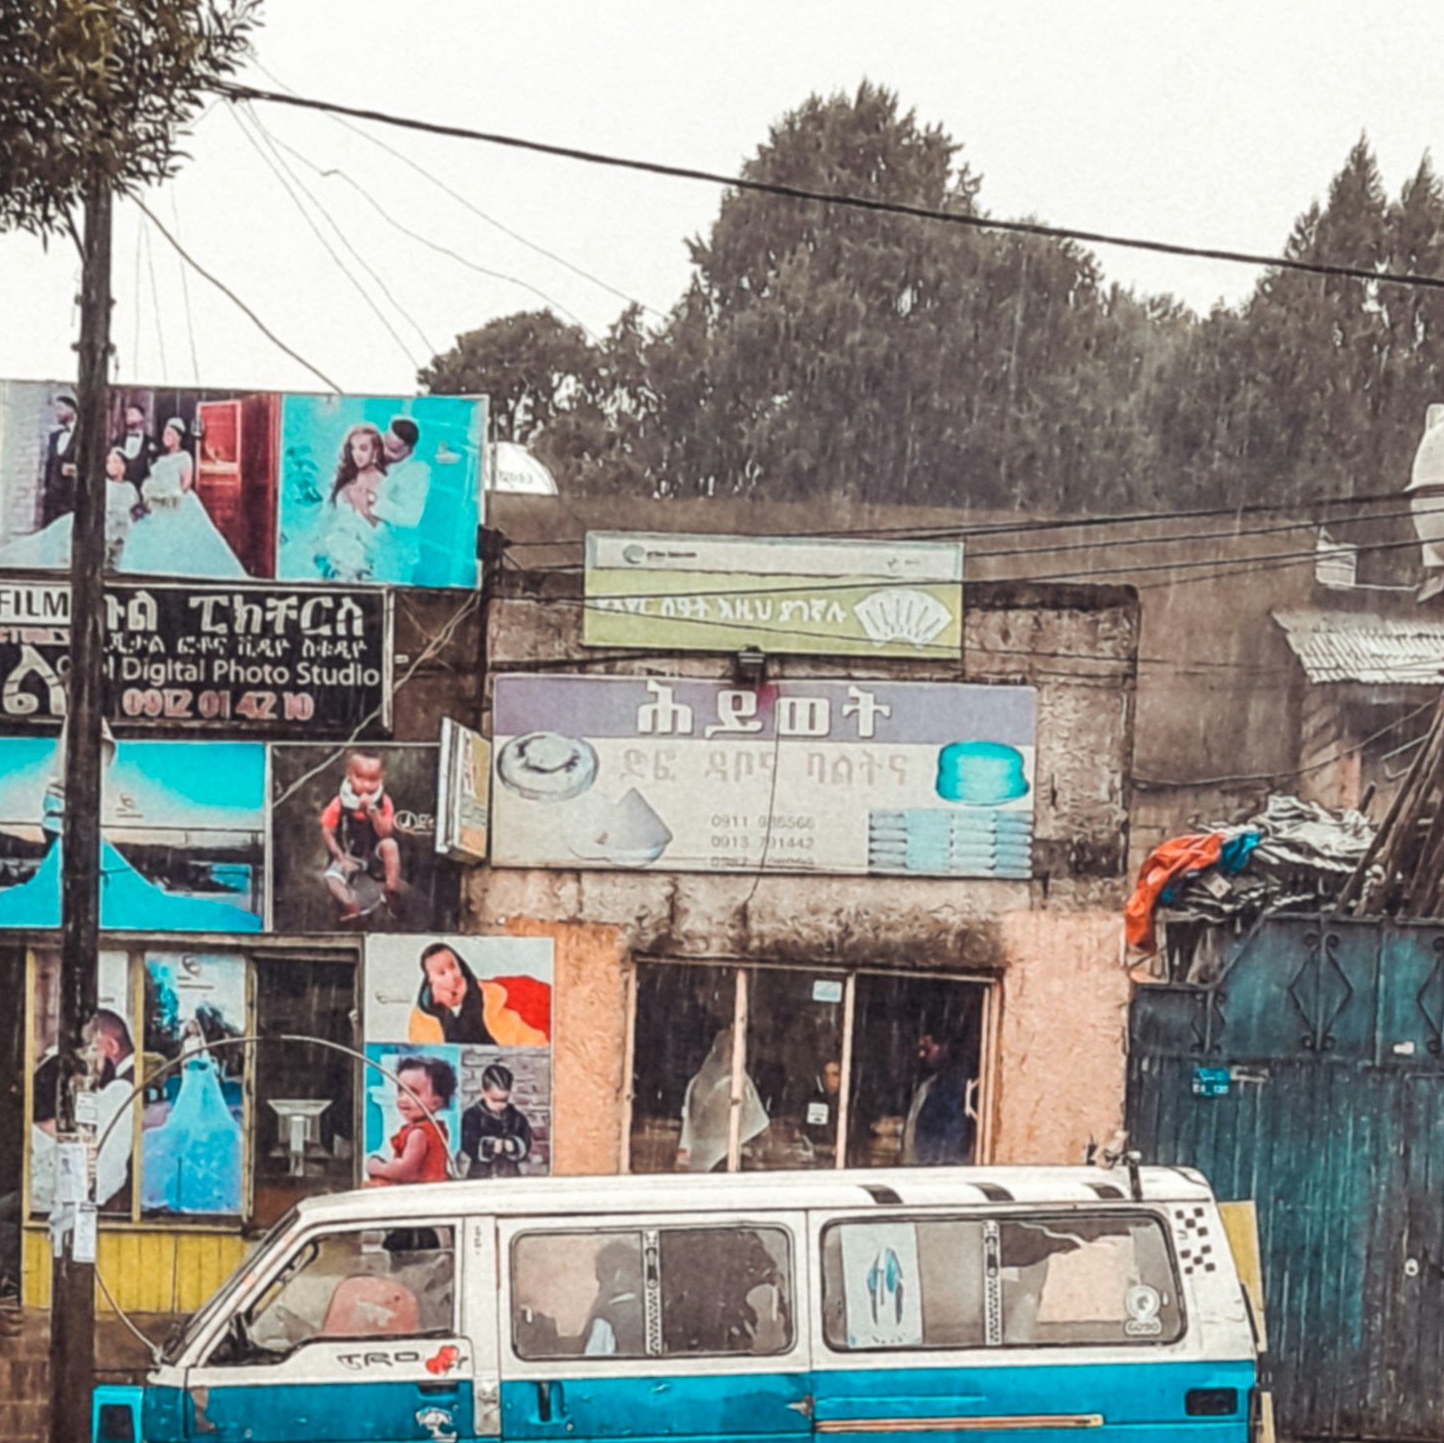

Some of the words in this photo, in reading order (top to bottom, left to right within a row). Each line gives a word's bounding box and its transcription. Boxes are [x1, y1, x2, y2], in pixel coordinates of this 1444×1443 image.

[188, 593, 365, 637] ፒክቸርስ
[56, 654, 115, 681] Cl
[122, 658, 205, 688] Digital
[212, 659, 290, 685] Photo
[296, 661, 380, 687] Studio
[122, 687, 193, 718] 0912
[198, 689, 231, 719] 01
[235, 690, 278, 720] 42
[282, 690, 315, 721] 10
